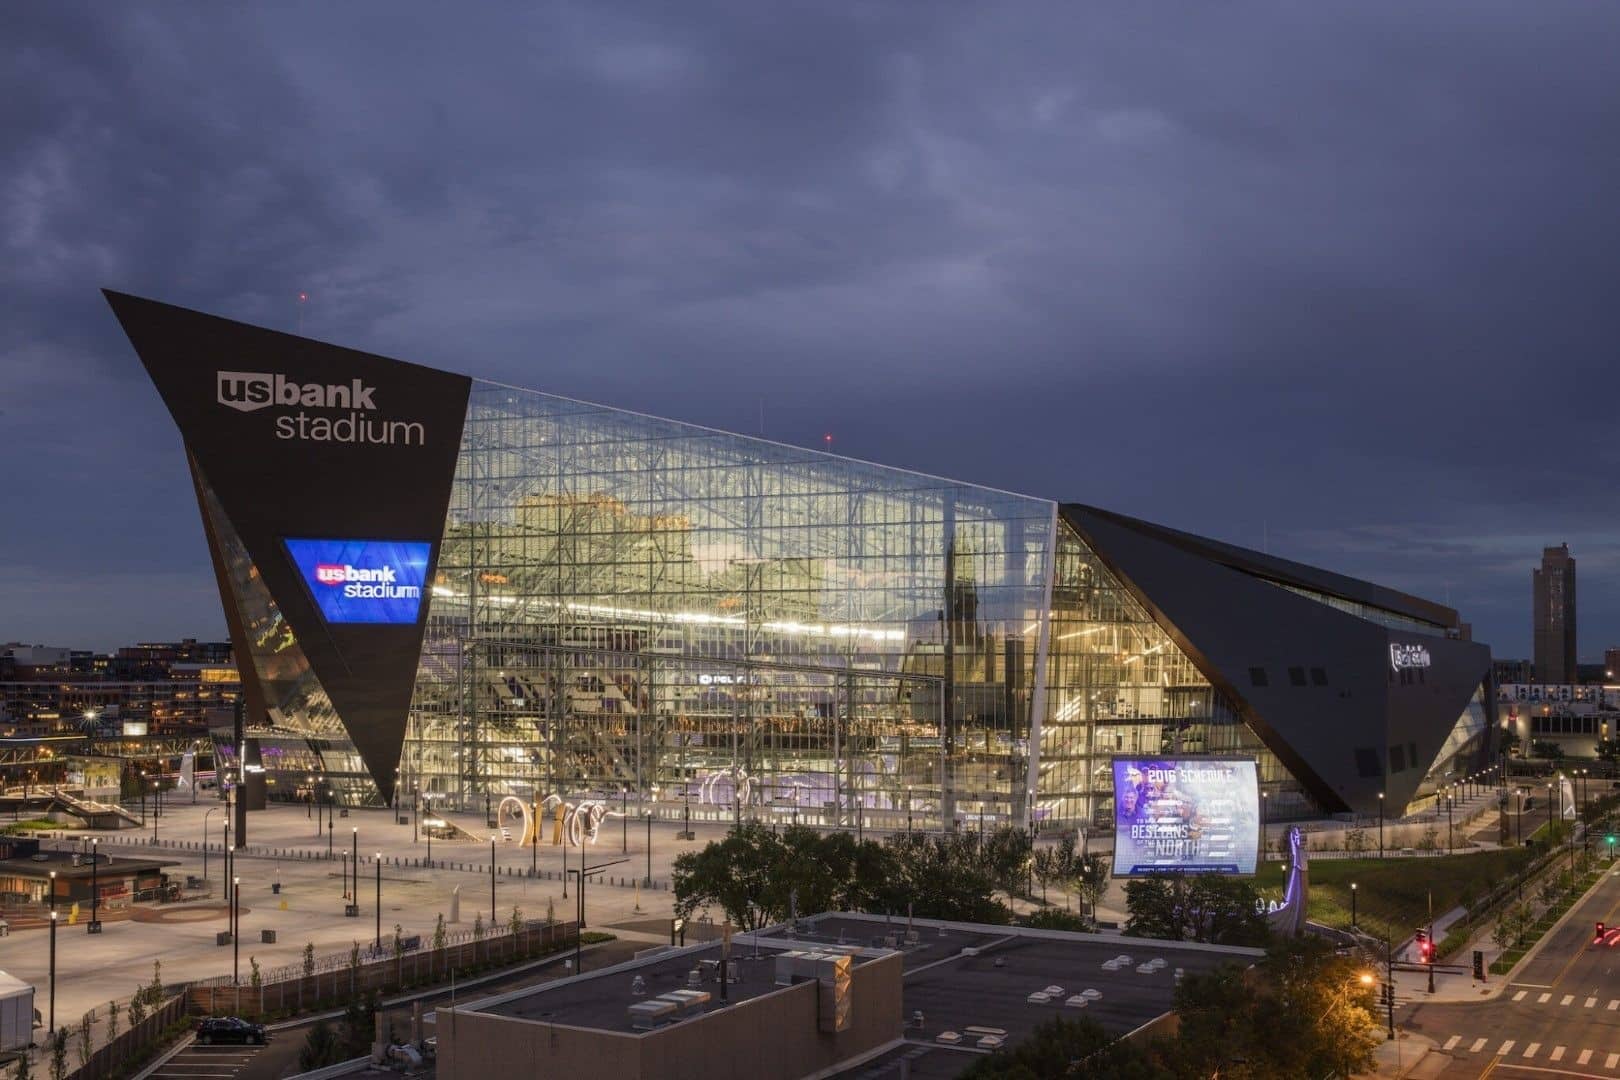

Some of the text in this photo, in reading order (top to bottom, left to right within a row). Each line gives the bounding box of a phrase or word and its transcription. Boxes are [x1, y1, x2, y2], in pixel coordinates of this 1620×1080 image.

[275, 411, 425, 446] stadium
[344, 582, 420, 599] stadium
[1148, 769, 1232, 782] 2016 SCHEDULE
[1155, 839, 1200, 857] NORTH
